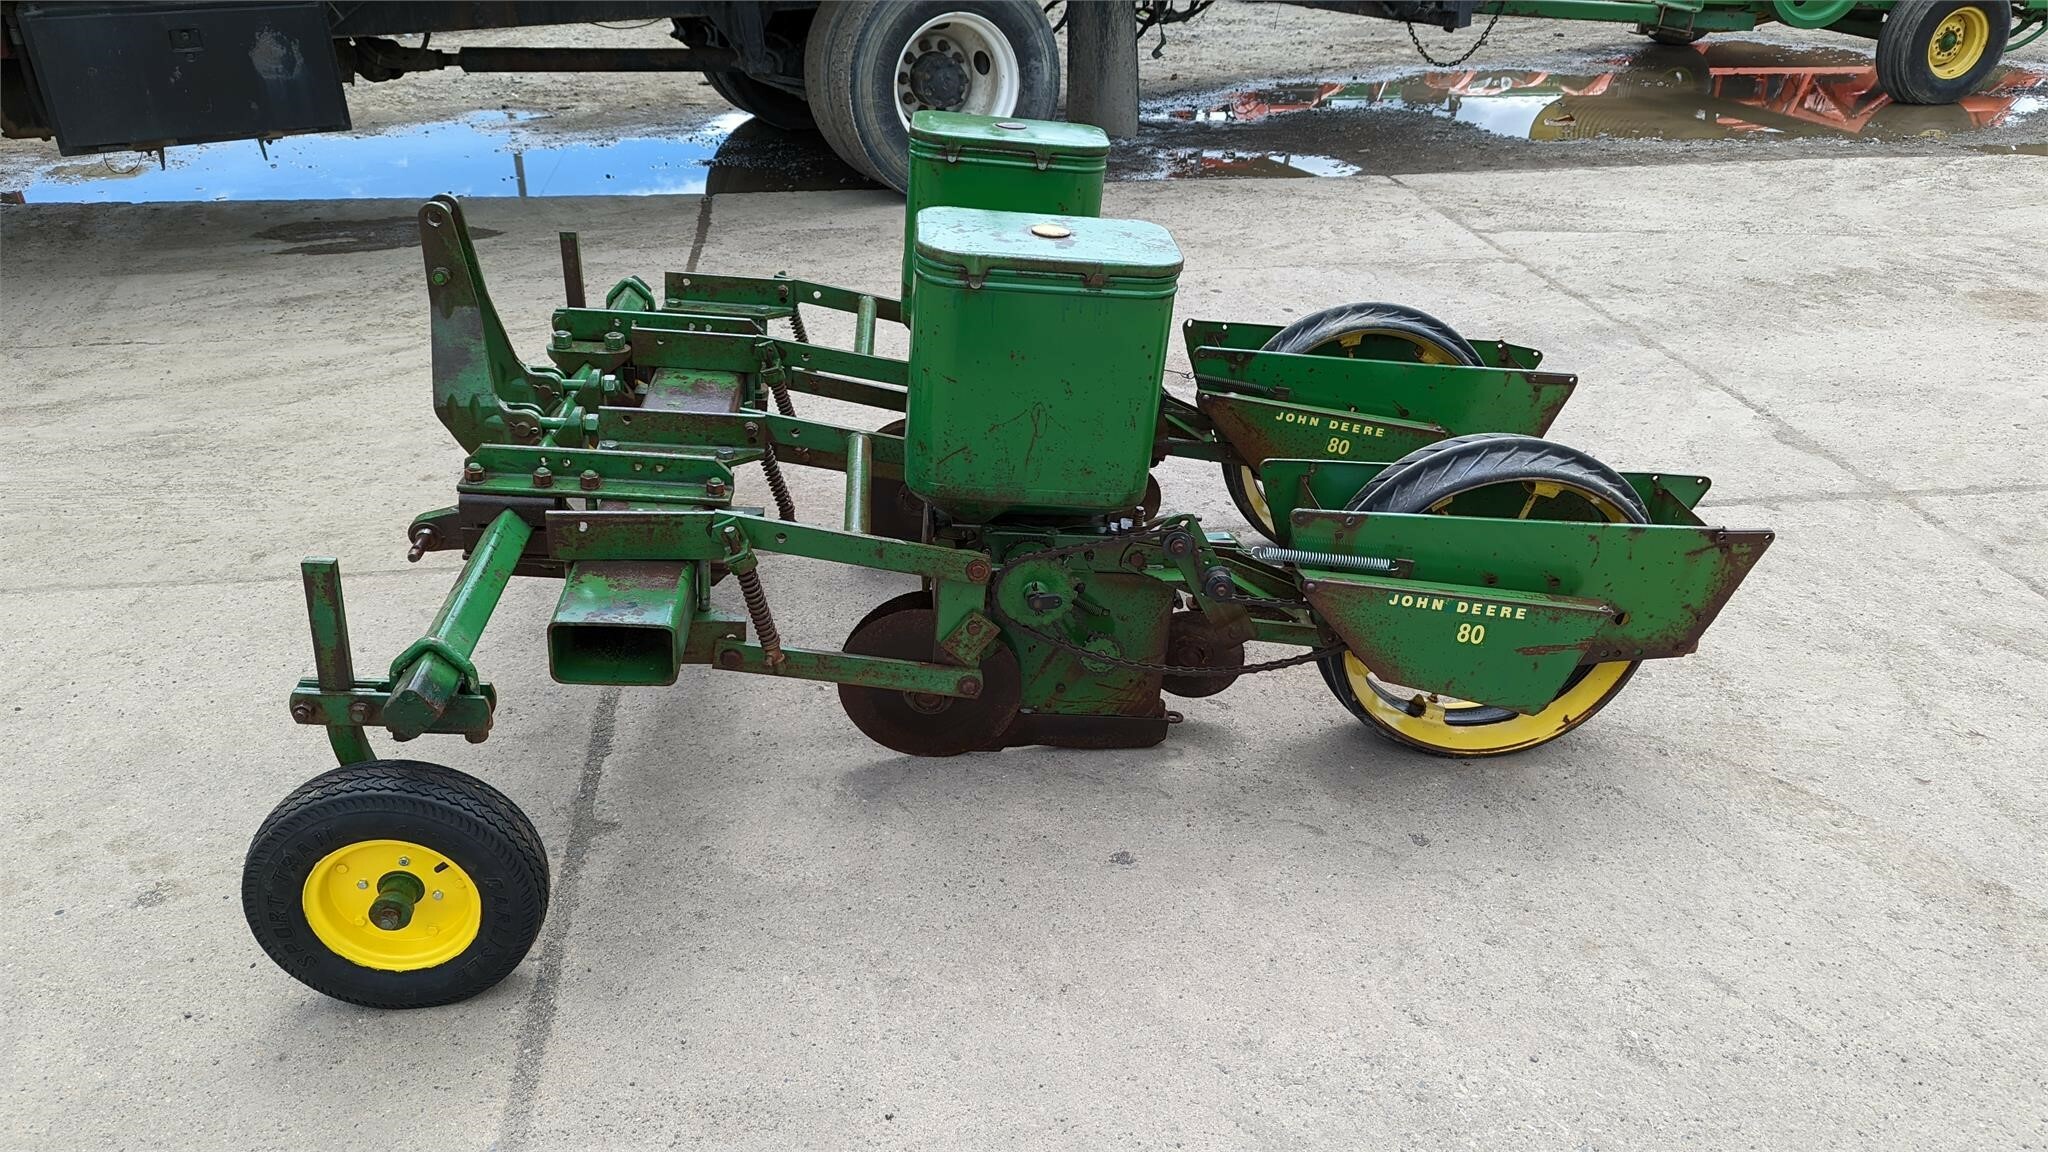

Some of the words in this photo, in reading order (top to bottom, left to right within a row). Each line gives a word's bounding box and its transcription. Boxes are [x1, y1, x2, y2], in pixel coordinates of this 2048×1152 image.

[1276, 412, 1320, 427] JOHN
[1329, 420, 1385, 437] DEERE
[1327, 437, 1350, 455] 80
[1388, 594, 1444, 611] JOHN
[1456, 601, 1527, 620] DEERE
[1456, 623, 1485, 645] 80
[267, 896, 321, 967] SPORT
